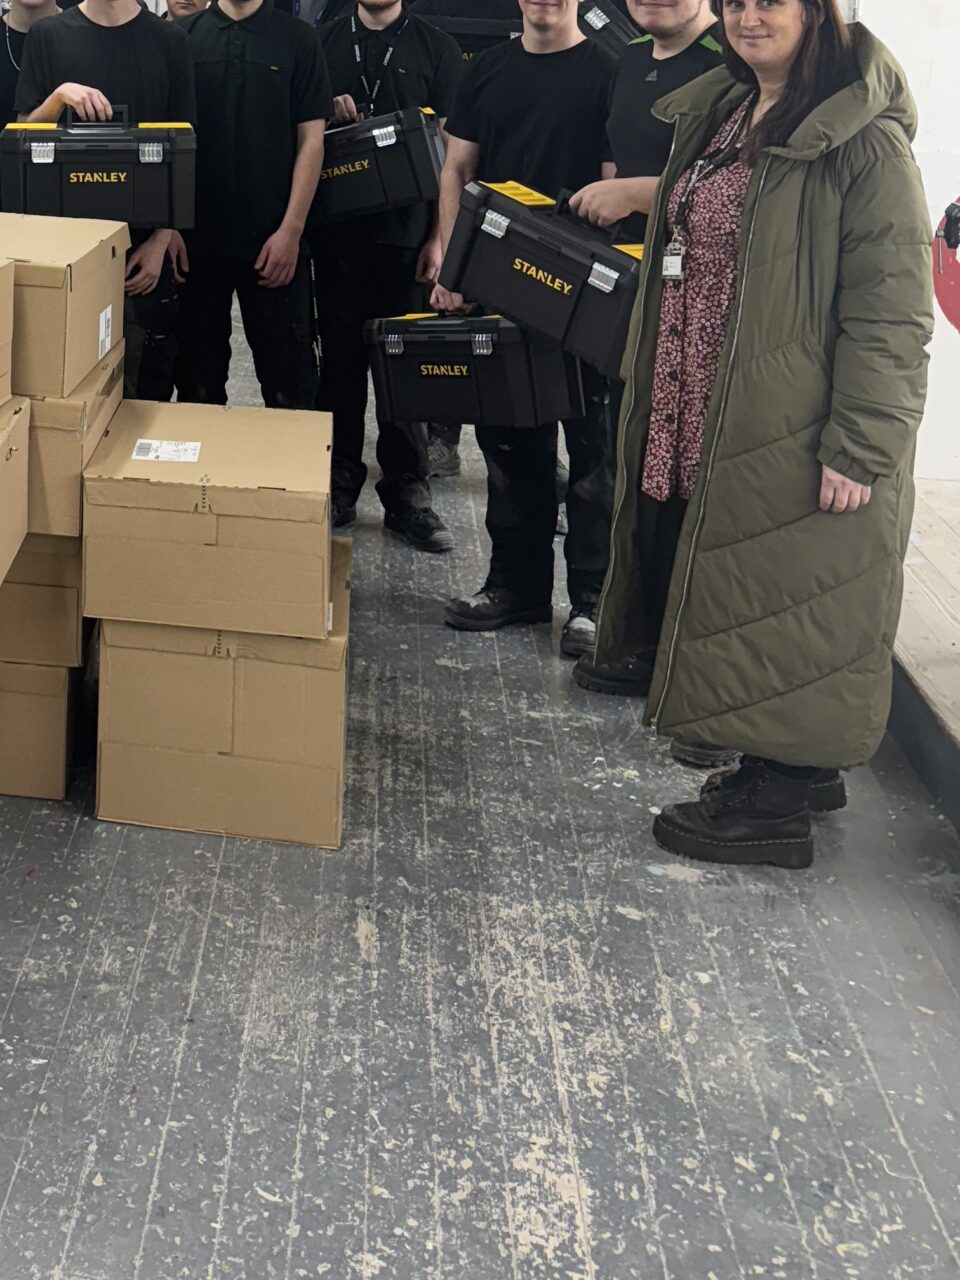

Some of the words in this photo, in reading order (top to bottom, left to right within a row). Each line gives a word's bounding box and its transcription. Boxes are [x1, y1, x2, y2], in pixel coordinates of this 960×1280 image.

[69, 172, 127, 183] STANLEY
[320, 159, 370, 180] STANLEY
[513, 258, 573, 296] STANLEY
[420, 364, 469, 376] STANLEY
